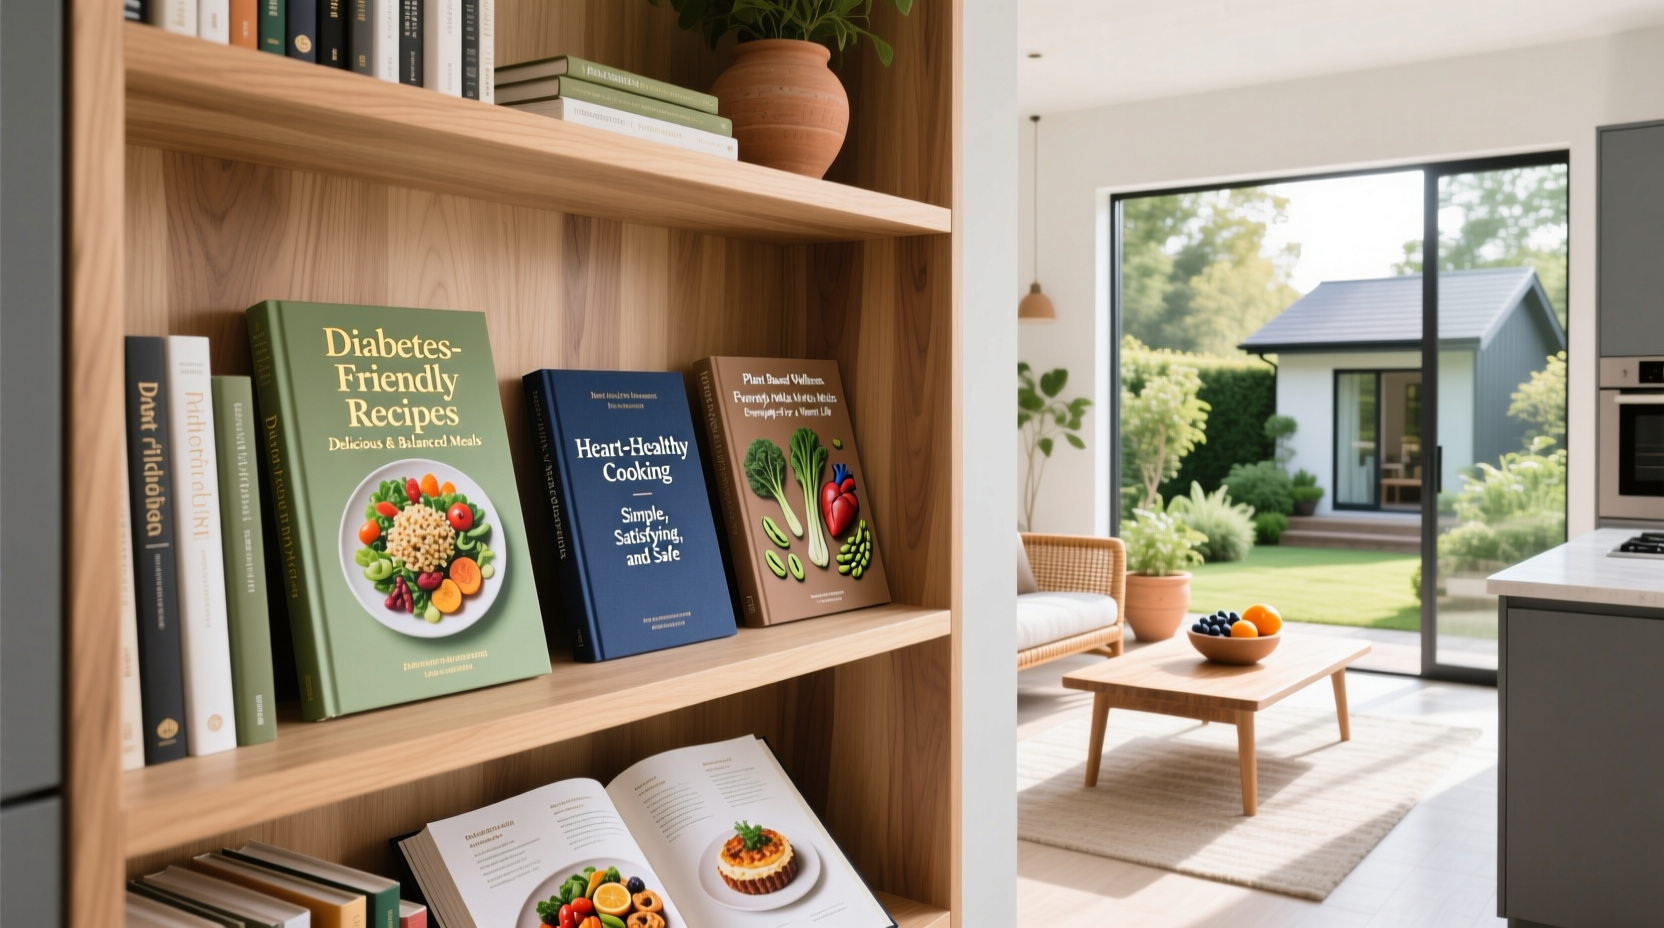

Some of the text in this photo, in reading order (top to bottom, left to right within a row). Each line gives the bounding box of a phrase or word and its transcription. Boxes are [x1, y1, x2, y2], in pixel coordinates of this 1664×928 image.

[322, 327, 462, 359] Diabetes-
[334, 363, 459, 401] Friendly
[345, 398, 460, 434] Recipes
[328, 436, 383, 451] Delicious
[385, 436, 395, 449] &
[574, 435, 689, 460] Heart-Healthy
[602, 460, 673, 485] Cooking
[620, 504, 669, 526] Simple,
[614, 525, 683, 548] Satisfying,
[626, 546, 651, 566] and
